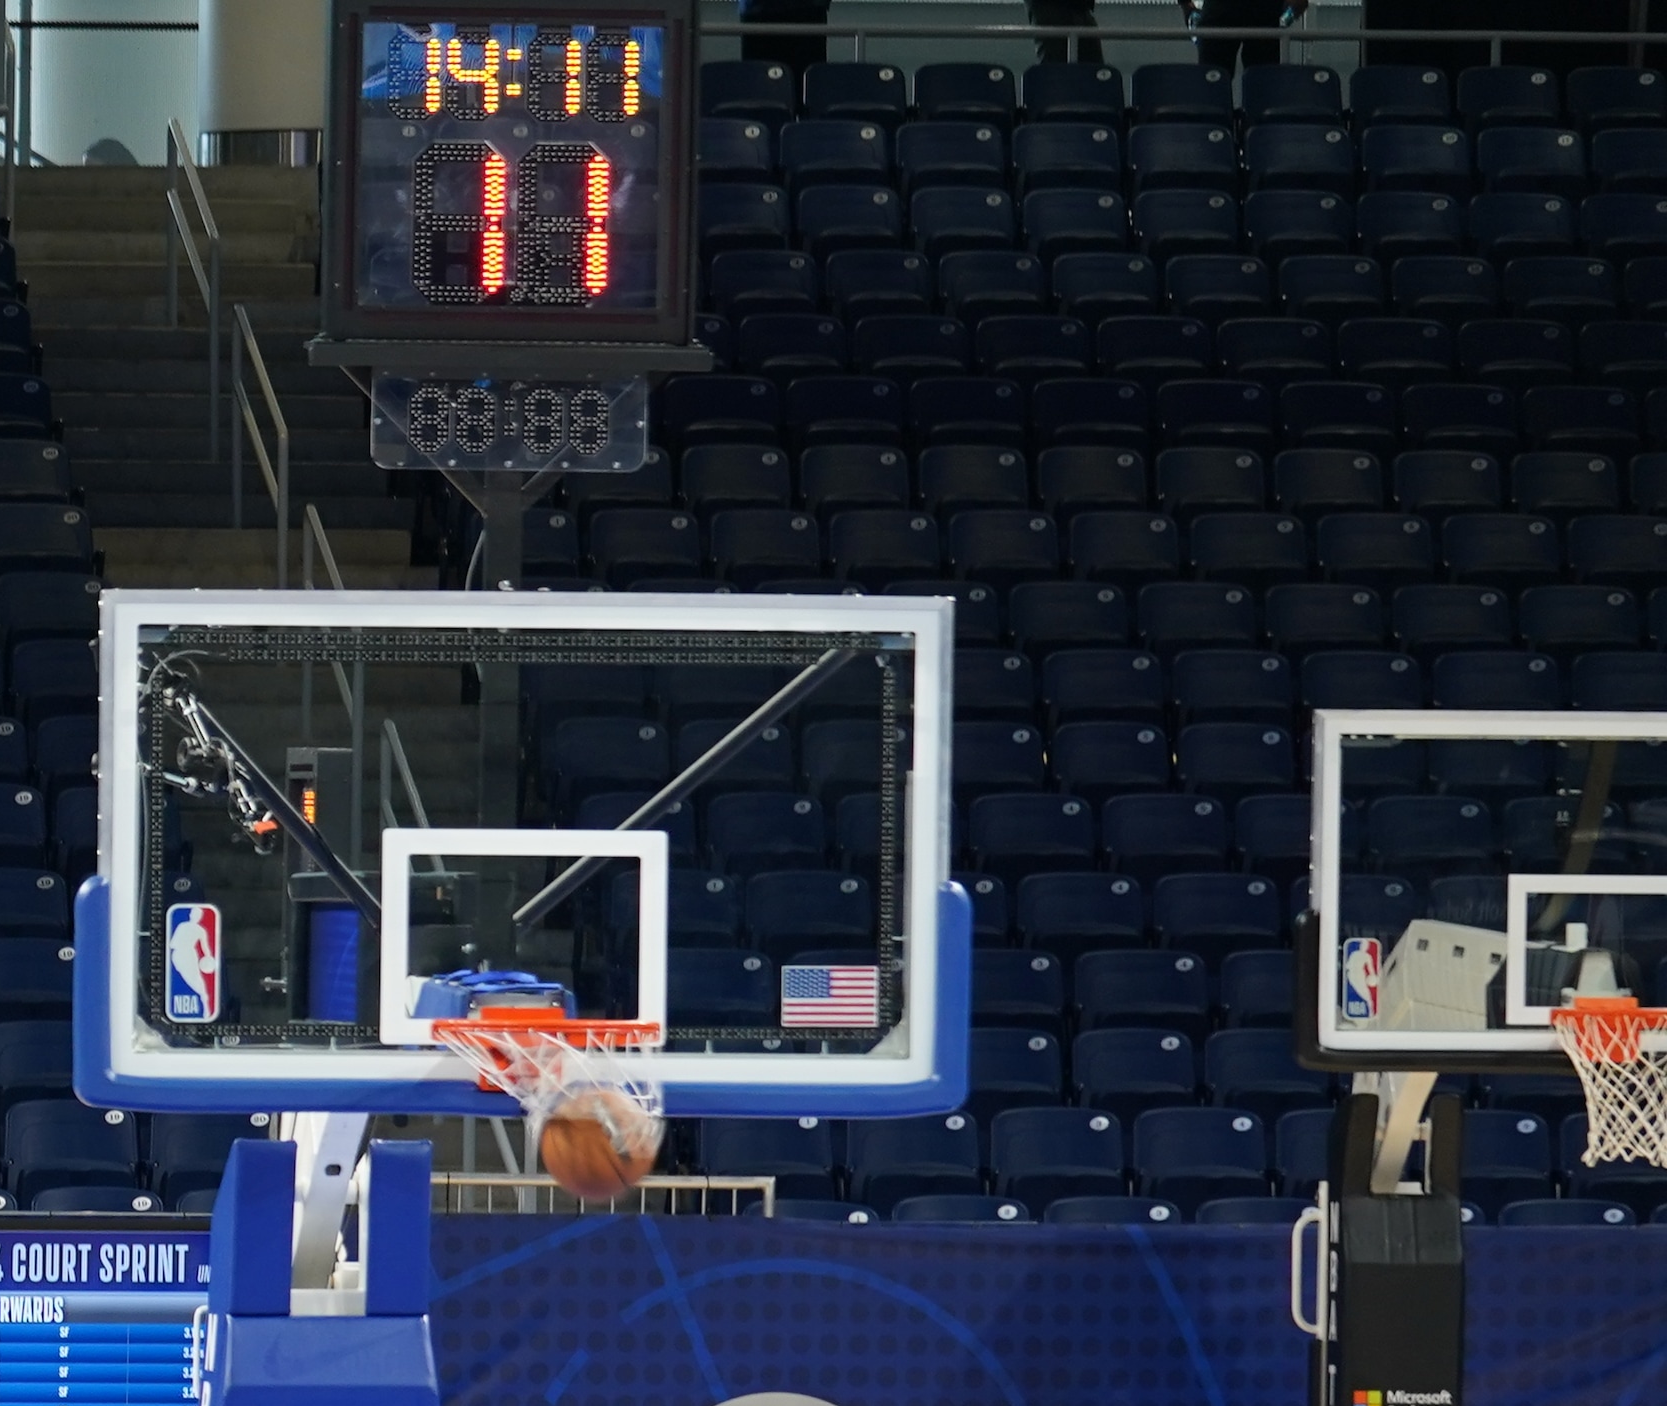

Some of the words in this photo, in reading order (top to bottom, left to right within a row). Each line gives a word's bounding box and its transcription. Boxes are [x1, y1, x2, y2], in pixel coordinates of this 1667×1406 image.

[424, 38, 640, 116] 14:11
[481, 153, 612, 295] 11
[174, 995, 199, 1014] NBA
[12, 1243, 91, 1283] COURT
[99, 1244, 189, 1283] SPRINT
[1386, 1390, 1452, 1405] Microsoft
